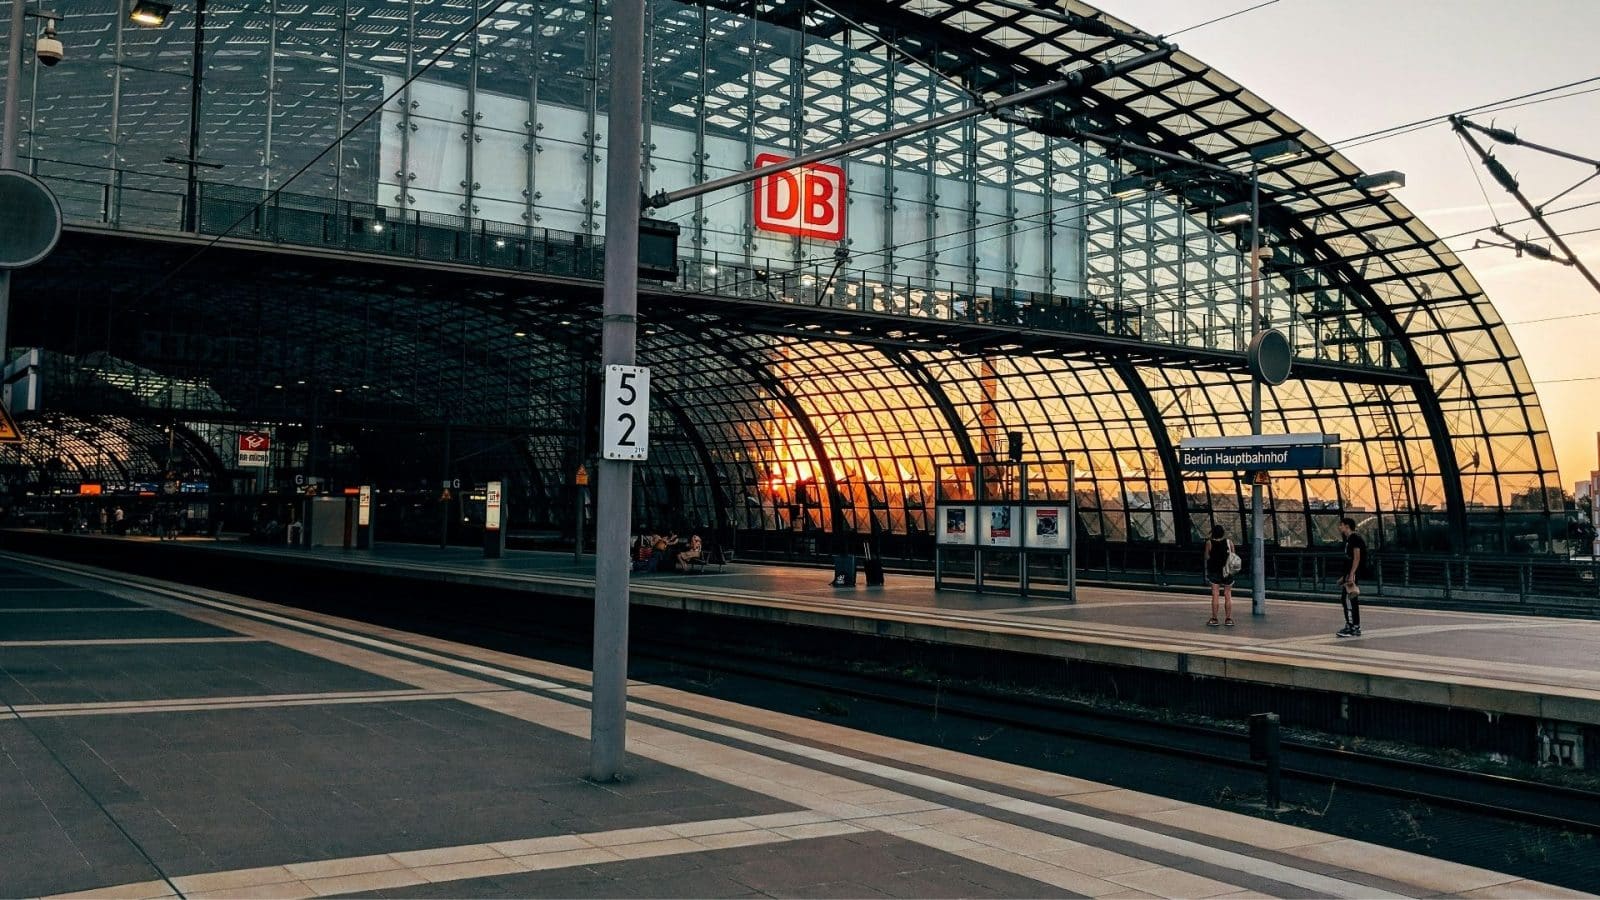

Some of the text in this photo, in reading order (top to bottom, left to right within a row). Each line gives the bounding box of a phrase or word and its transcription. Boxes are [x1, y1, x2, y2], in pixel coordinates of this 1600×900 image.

[767, 169, 834, 226] DB
[617, 373, 636, 406] 5
[617, 413, 636, 447] 2
[1184, 451, 1288, 466] Berlin Hauptbahnhof
[295, 474, 304, 485] G
[453, 478, 460, 489] G
